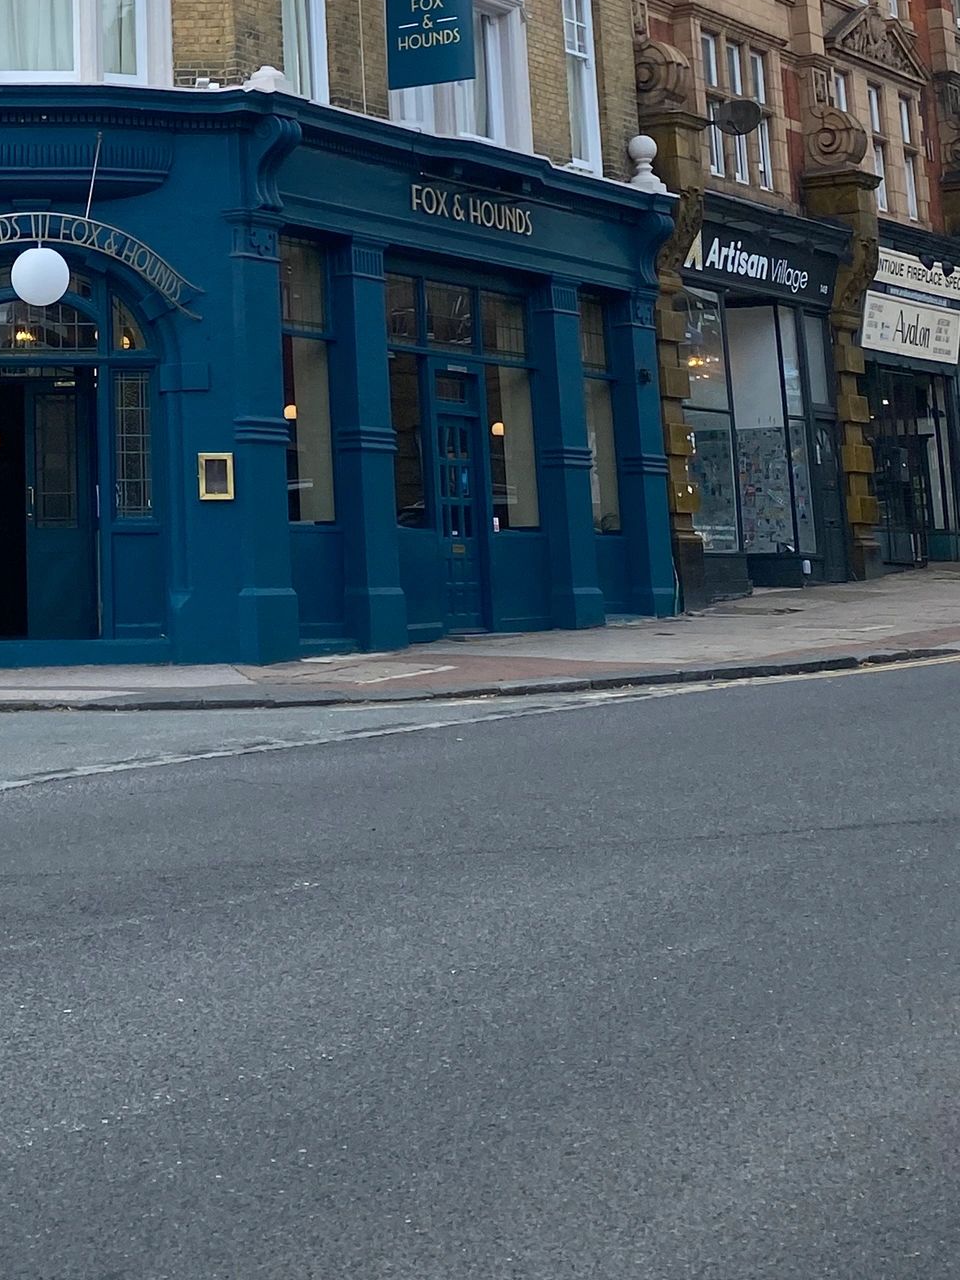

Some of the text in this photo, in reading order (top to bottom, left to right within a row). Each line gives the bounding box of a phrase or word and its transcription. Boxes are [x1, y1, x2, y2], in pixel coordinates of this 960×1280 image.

[398, 27, 461, 51] HOUNDS
[421, 14, 434, 29] &
[411, 184, 533, 236] FOX & HOUNDS
[60, 217, 184, 301] FOX & HOUNDS
[705, 237, 808, 293] Artisan Village
[879, 258, 905, 277] NTIQUE
[907, 265, 942, 286] FIREPLACE
